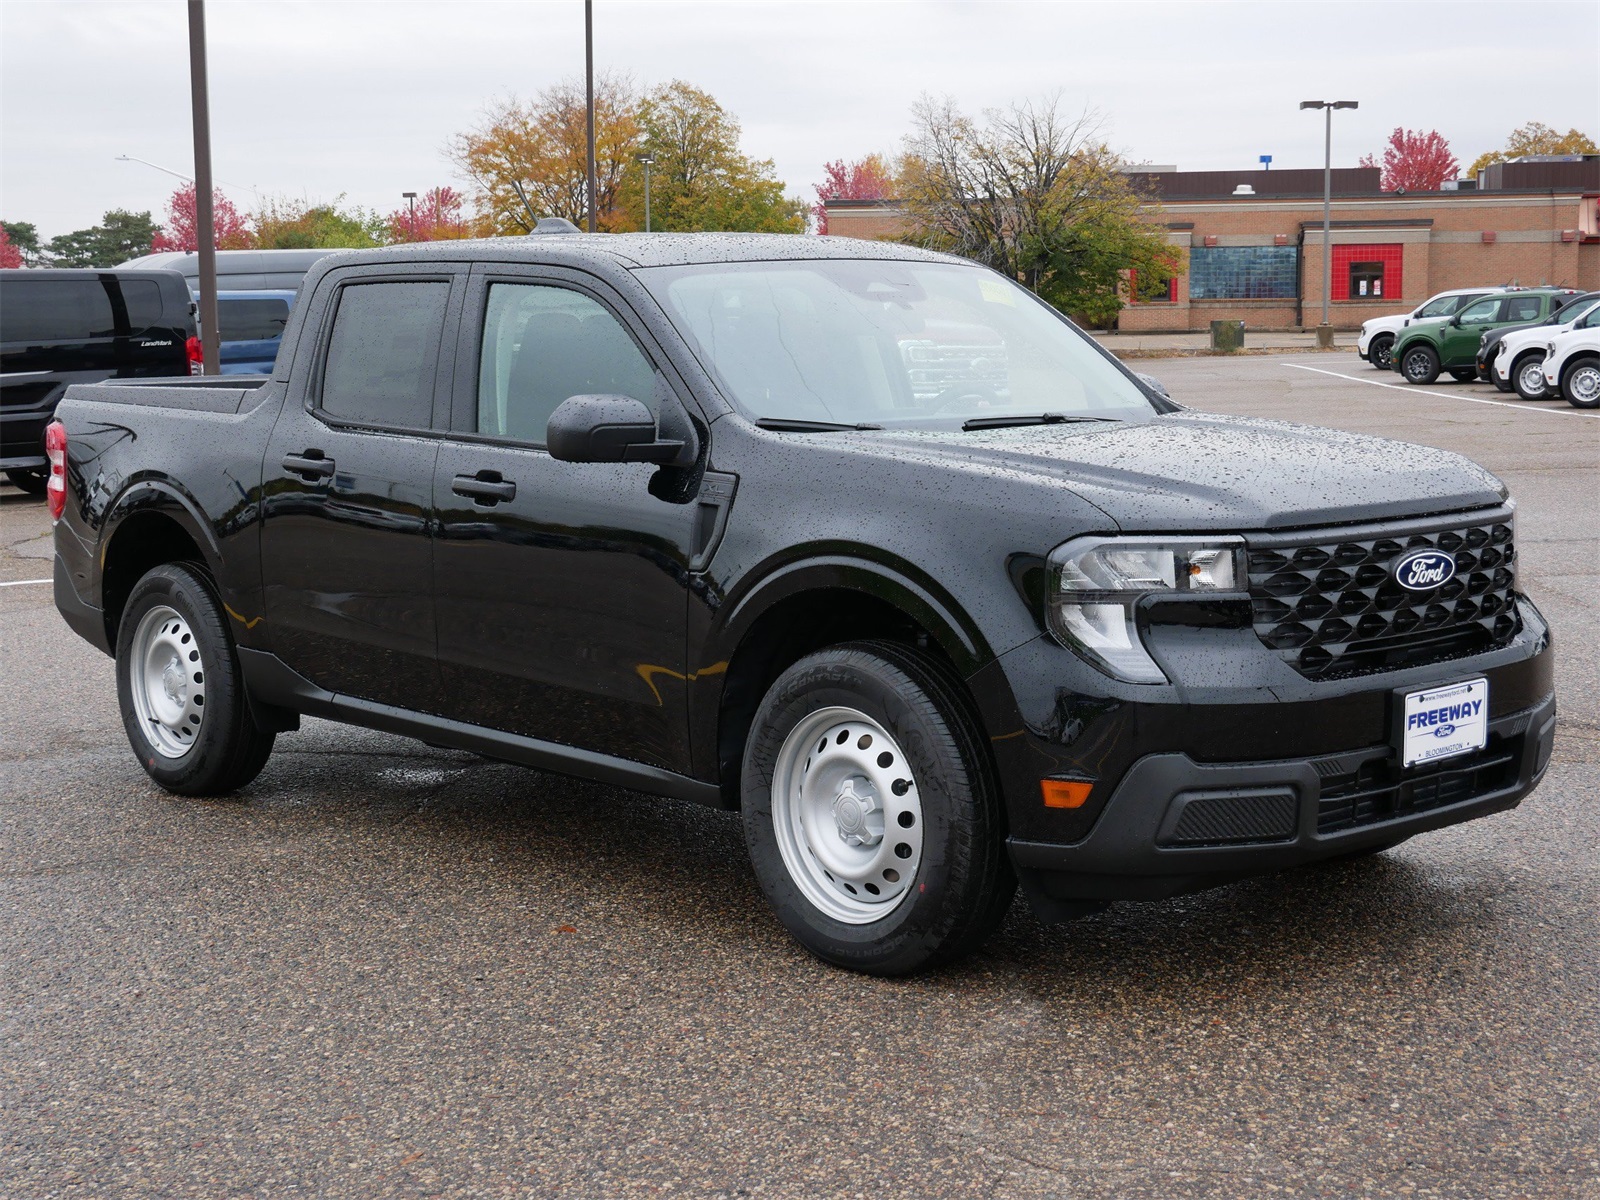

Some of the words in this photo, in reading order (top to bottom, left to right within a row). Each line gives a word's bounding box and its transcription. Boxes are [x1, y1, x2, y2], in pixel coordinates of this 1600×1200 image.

[704, 483, 724, 494] XL
[1408, 558, 1445, 585] Ford
[1408, 699, 1483, 731] FREEWAY
[1436, 725, 1453, 737] Ford
[1425, 742, 1463, 758] BLOOMINGTON
